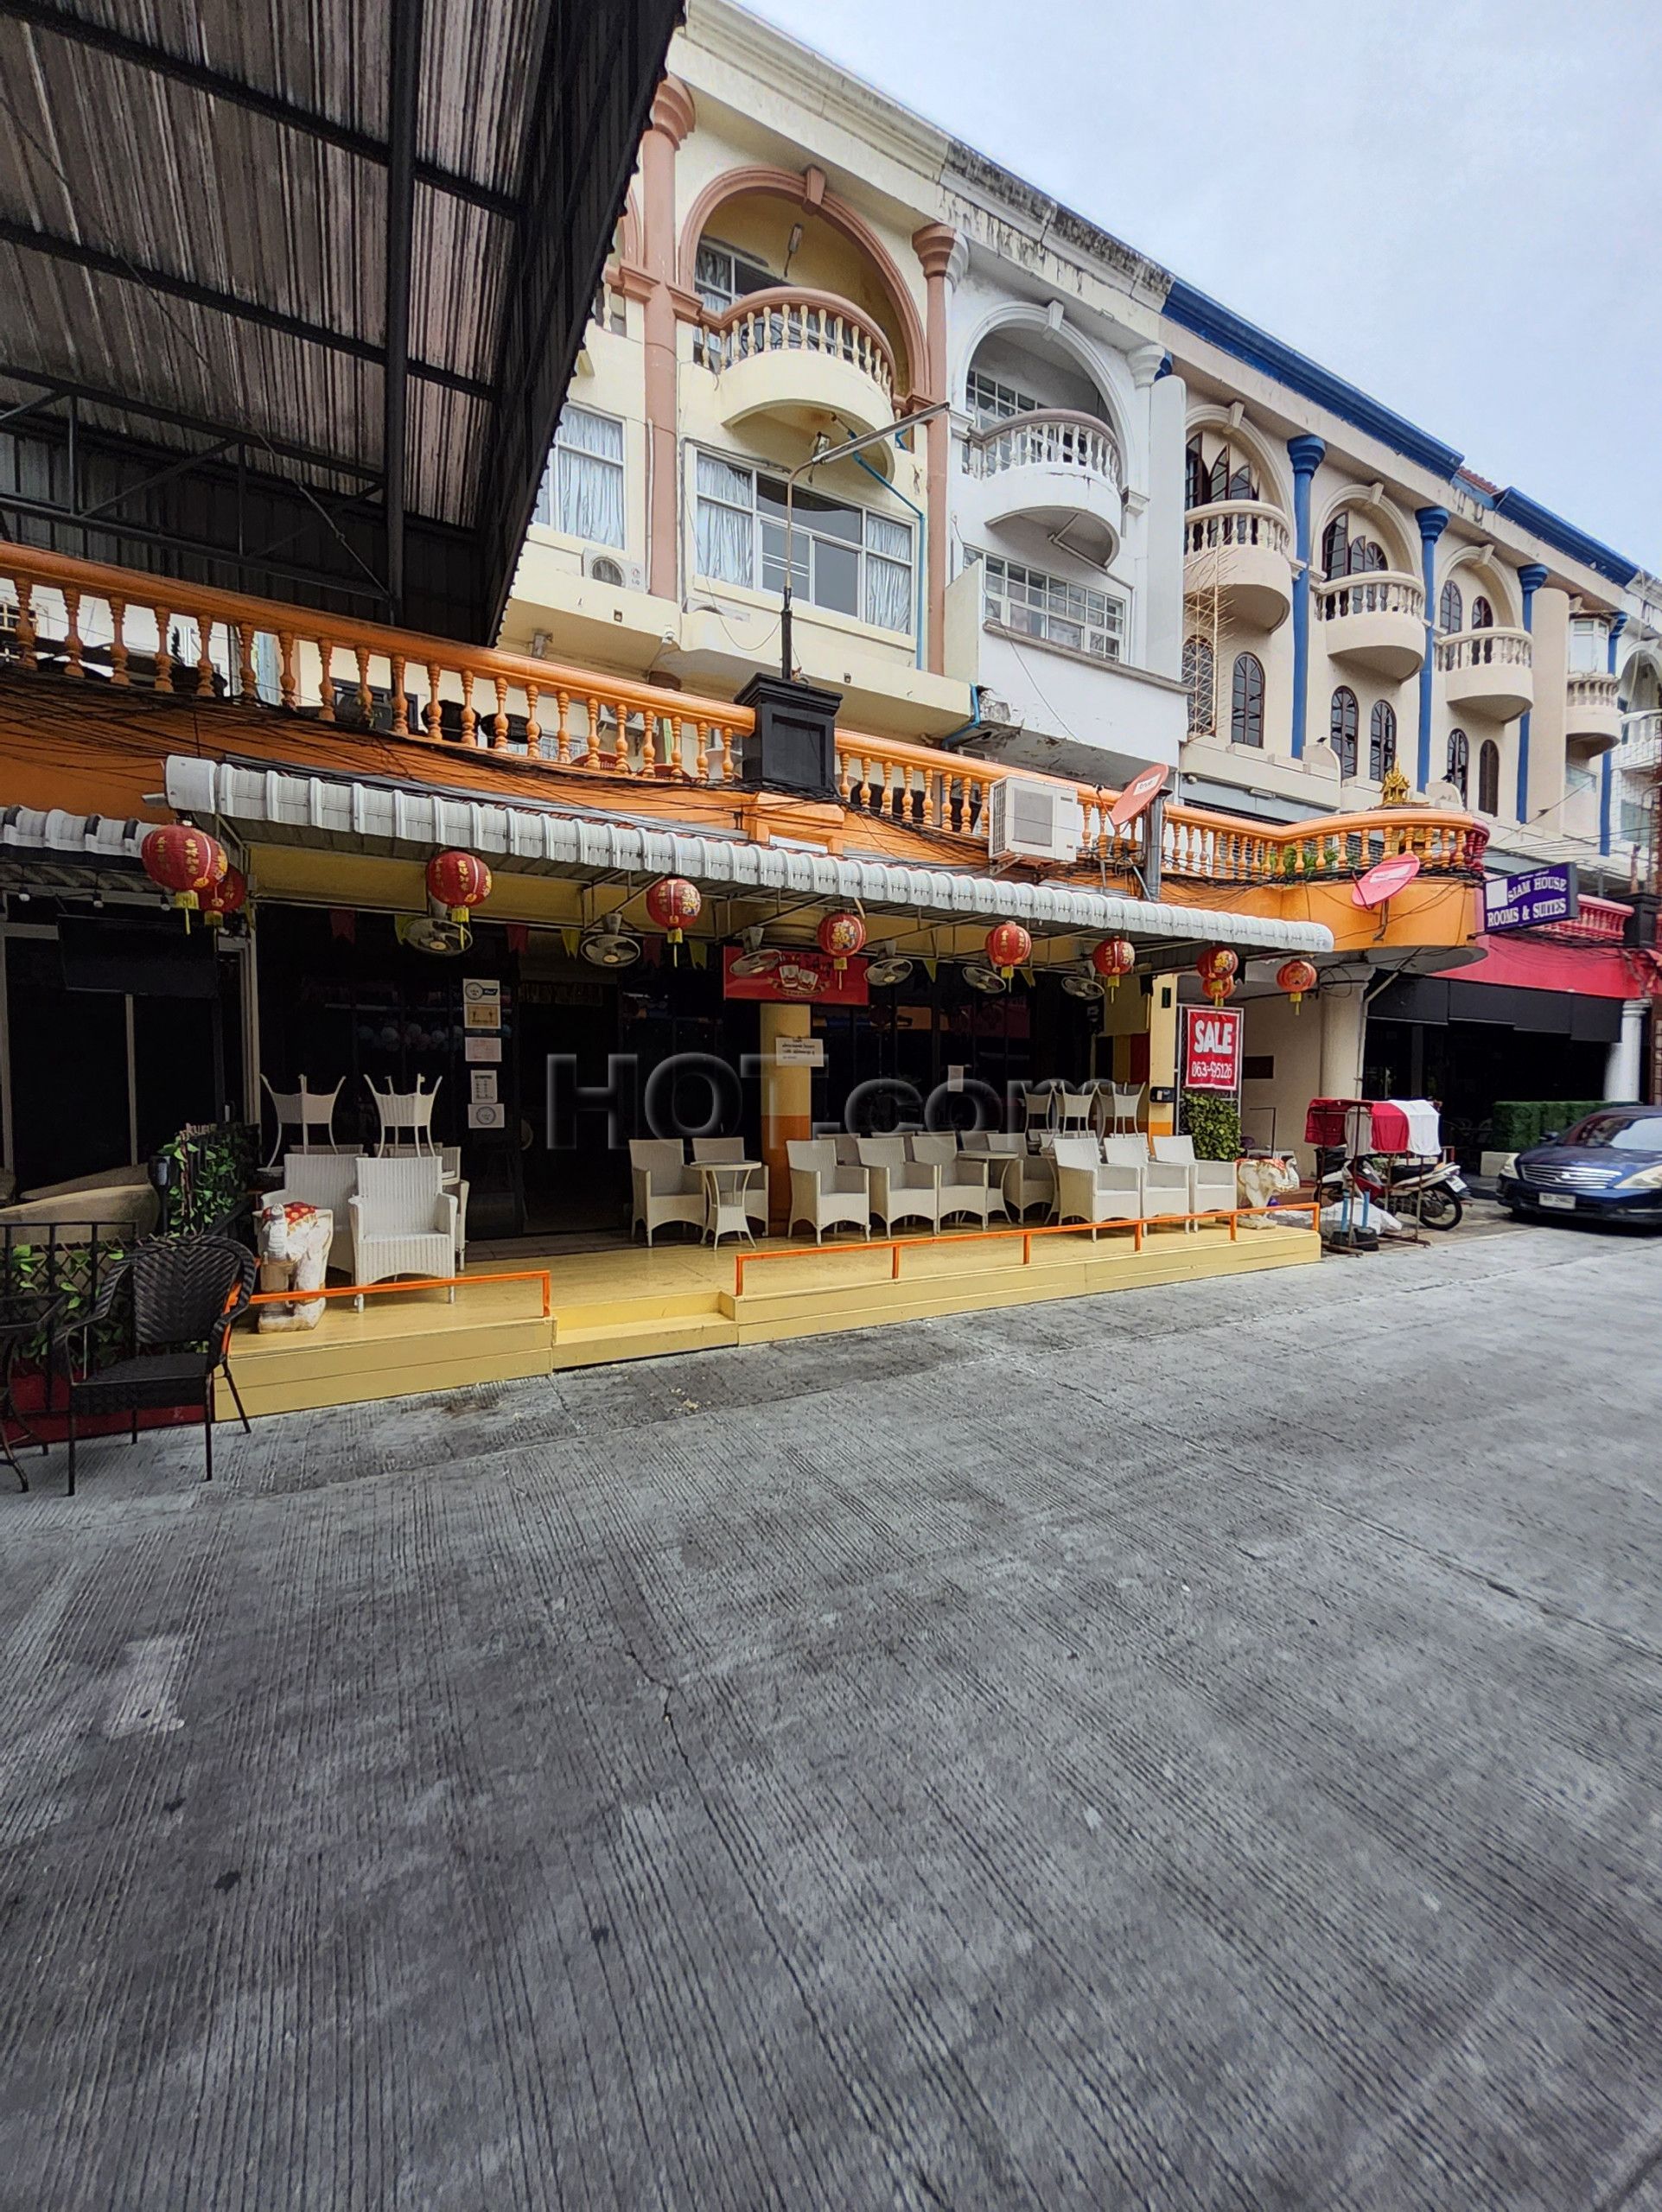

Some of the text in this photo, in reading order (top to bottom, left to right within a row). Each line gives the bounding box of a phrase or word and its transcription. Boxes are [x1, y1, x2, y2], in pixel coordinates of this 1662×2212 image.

[1507, 876, 1567, 903] SIAM HOUSE
[1487, 897, 1567, 927] ROOMS & SUITES
[1194, 1020, 1233, 1055] SALE
